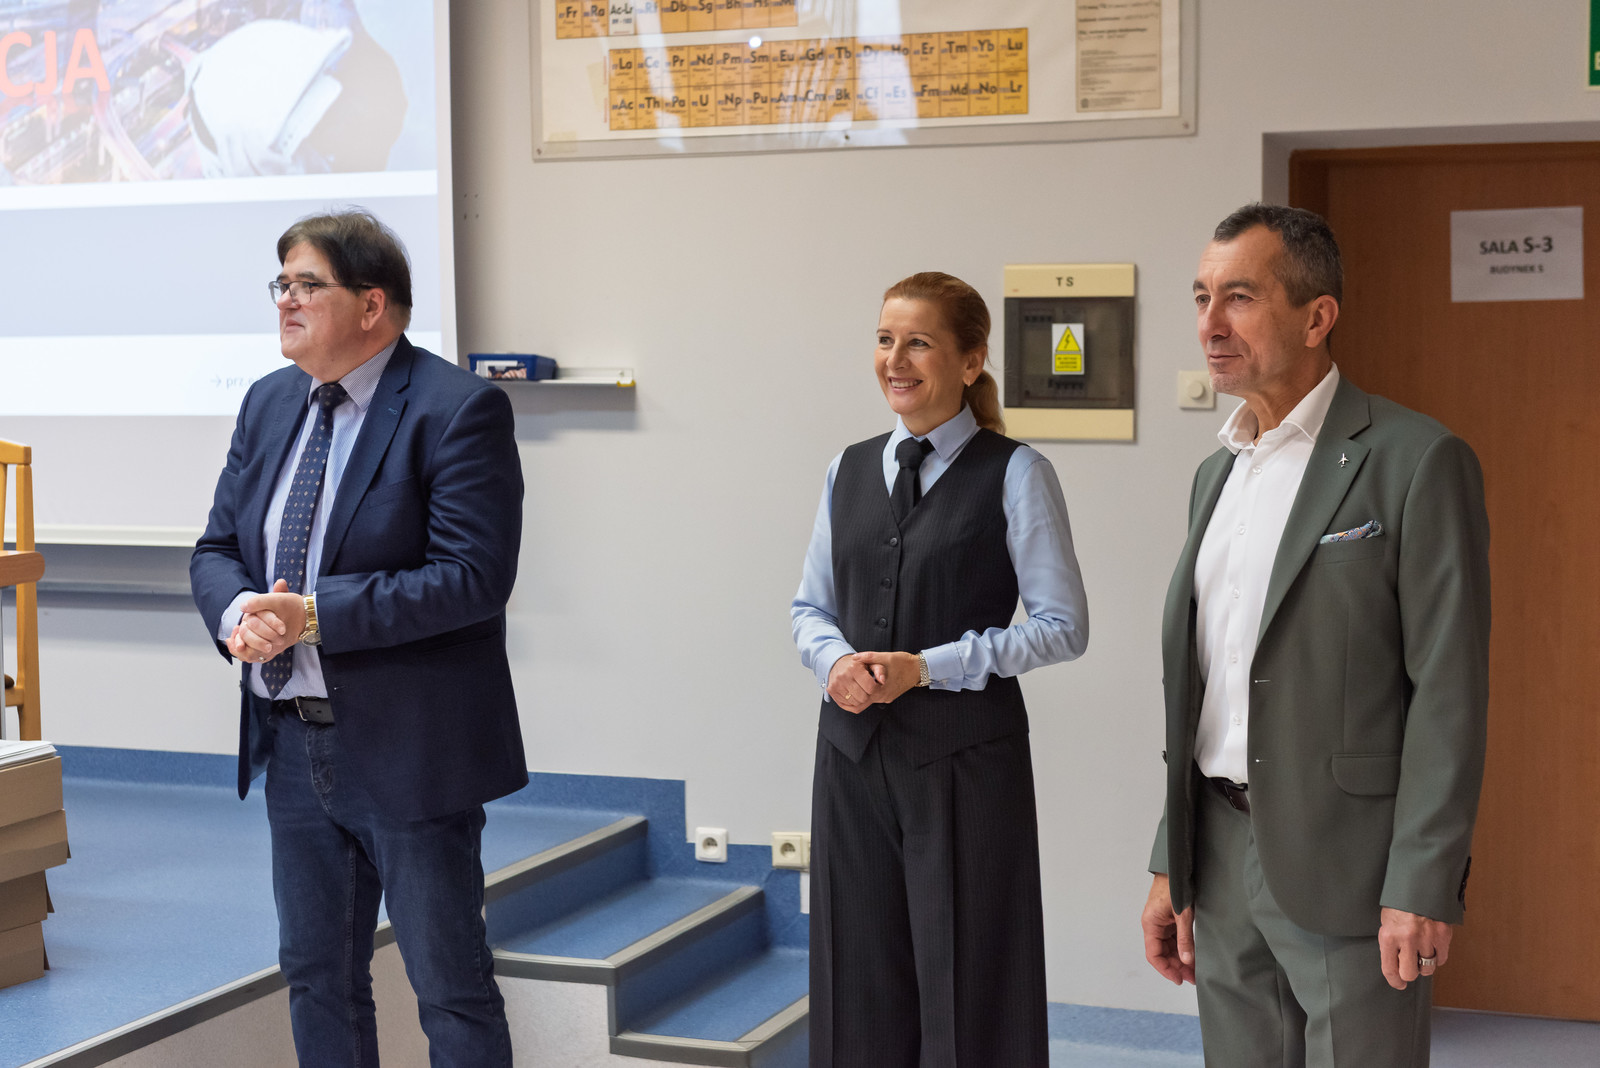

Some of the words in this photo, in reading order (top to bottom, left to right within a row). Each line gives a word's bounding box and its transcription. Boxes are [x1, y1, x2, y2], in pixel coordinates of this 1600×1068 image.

[0, 28, 111, 98] CJA
[672, 54, 685, 67] Pr
[696, 53, 714, 66] Nd
[723, 52, 742, 64] Pm
[750, 50, 769, 63] Sm
[780, 49, 795, 62] Eu
[806, 48, 825, 61] Gd
[835, 46, 852, 59] Tb
[921, 42, 935, 55] Er
[946, 40, 967, 53] Tm
[977, 39, 995, 52] Yb
[1007, 38, 1023, 51] Lu
[618, 99, 633, 110] Ac
[644, 96, 660, 109] Th
[699, 94, 709, 107] U
[724, 93, 742, 107] Np
[753, 91, 768, 104] Pu
[979, 81, 997, 94] No
[1009, 79, 1023, 93] Lr
[1479, 240, 1519, 255] SALA
[1523, 236, 1553, 254] S-3
